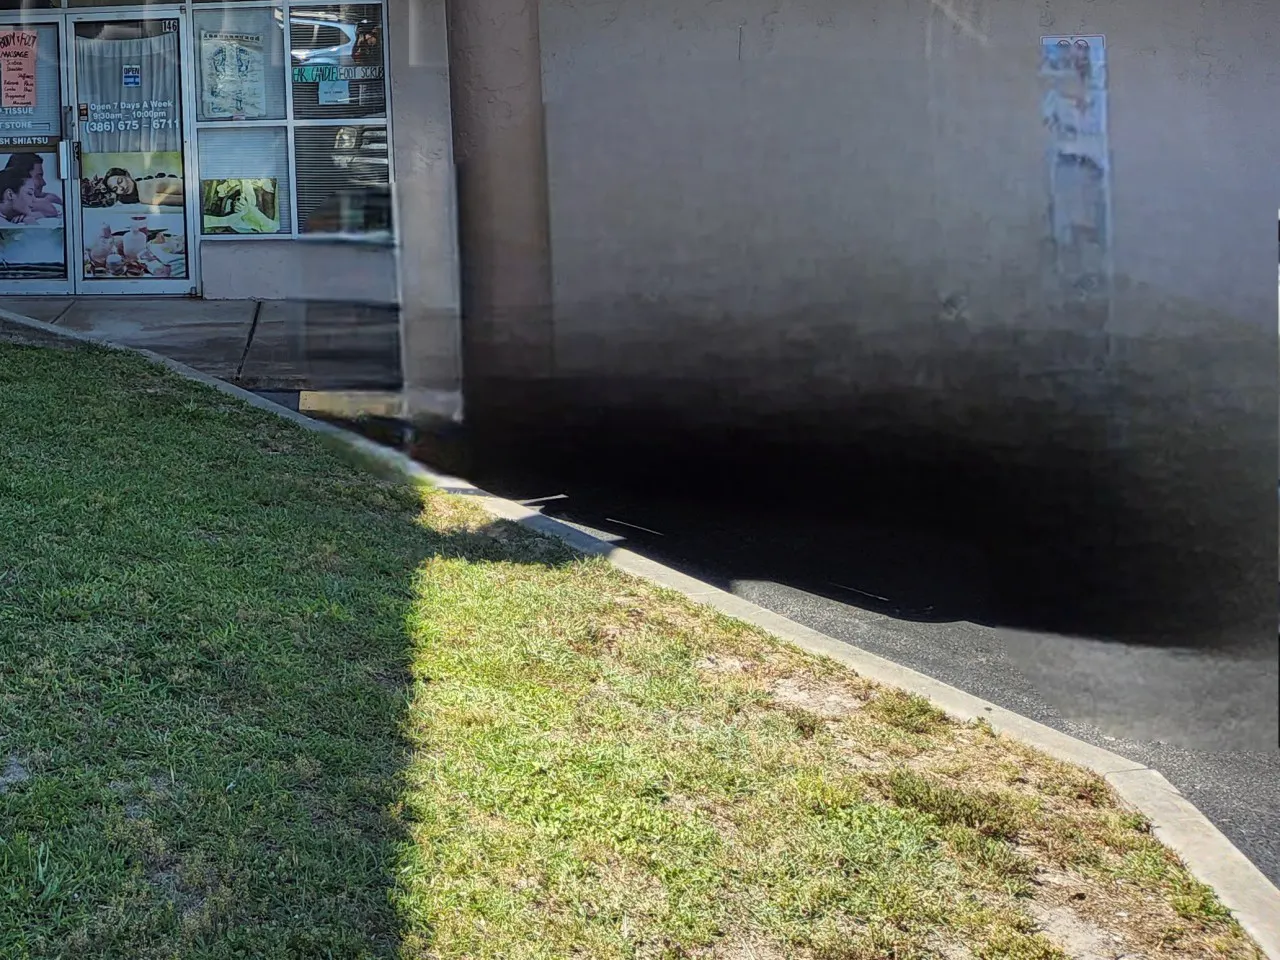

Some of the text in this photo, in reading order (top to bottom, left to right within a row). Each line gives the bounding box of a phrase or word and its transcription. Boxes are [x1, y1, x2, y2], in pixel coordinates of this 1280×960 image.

[163, 21, 177, 32] 146
[0, 32, 15, 49] BODY
[20, 32, 37, 48] FOOT
[293, 68, 305, 82] EAR
[338, 68, 356, 79] FOOT
[5, 107, 33, 115] TISSUE
[90, 103, 111, 111] Open
[121, 102, 140, 110] Days
[93, 111, 122, 120] 9:30am
[132, 111, 166, 119] 10:00pm
[5, 121, 33, 129] STONE
[86, 121, 115, 133] (386)
[118, 121, 139, 130] 675
[152, 119, 179, 129] 6711
[13, 137, 48, 145] SHIATSU
